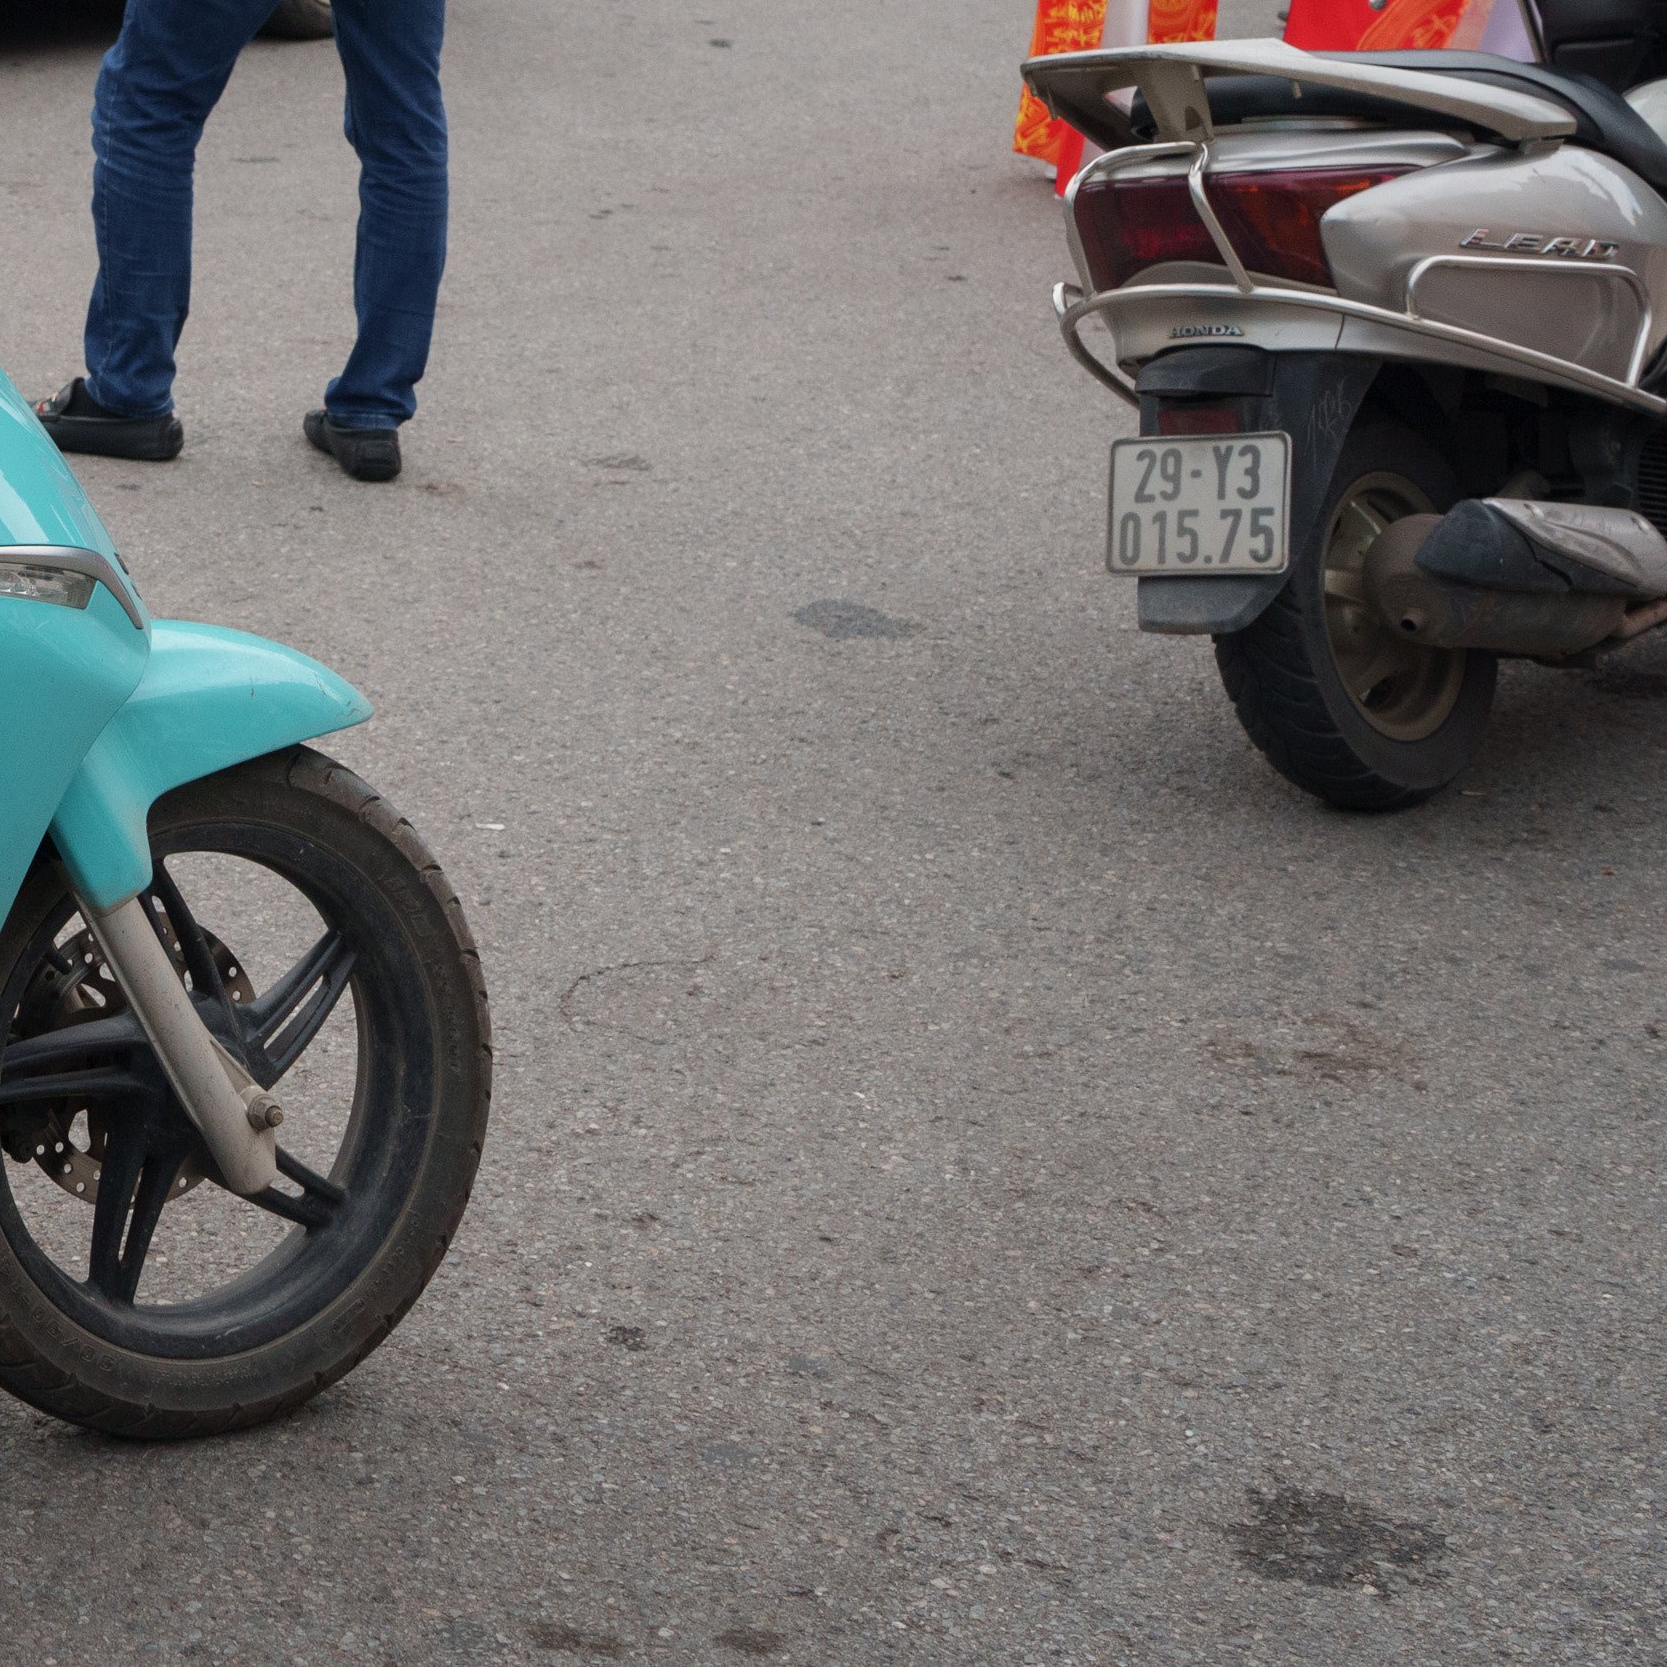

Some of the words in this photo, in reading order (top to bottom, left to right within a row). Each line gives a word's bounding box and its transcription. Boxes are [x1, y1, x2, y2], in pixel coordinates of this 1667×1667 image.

[1459, 227, 1619, 260] LEAD
[1169, 323, 1245, 338] HONDA
[1134, 443, 1262, 504] 29-Y3
[1119, 507, 1276, 567] 015.75
